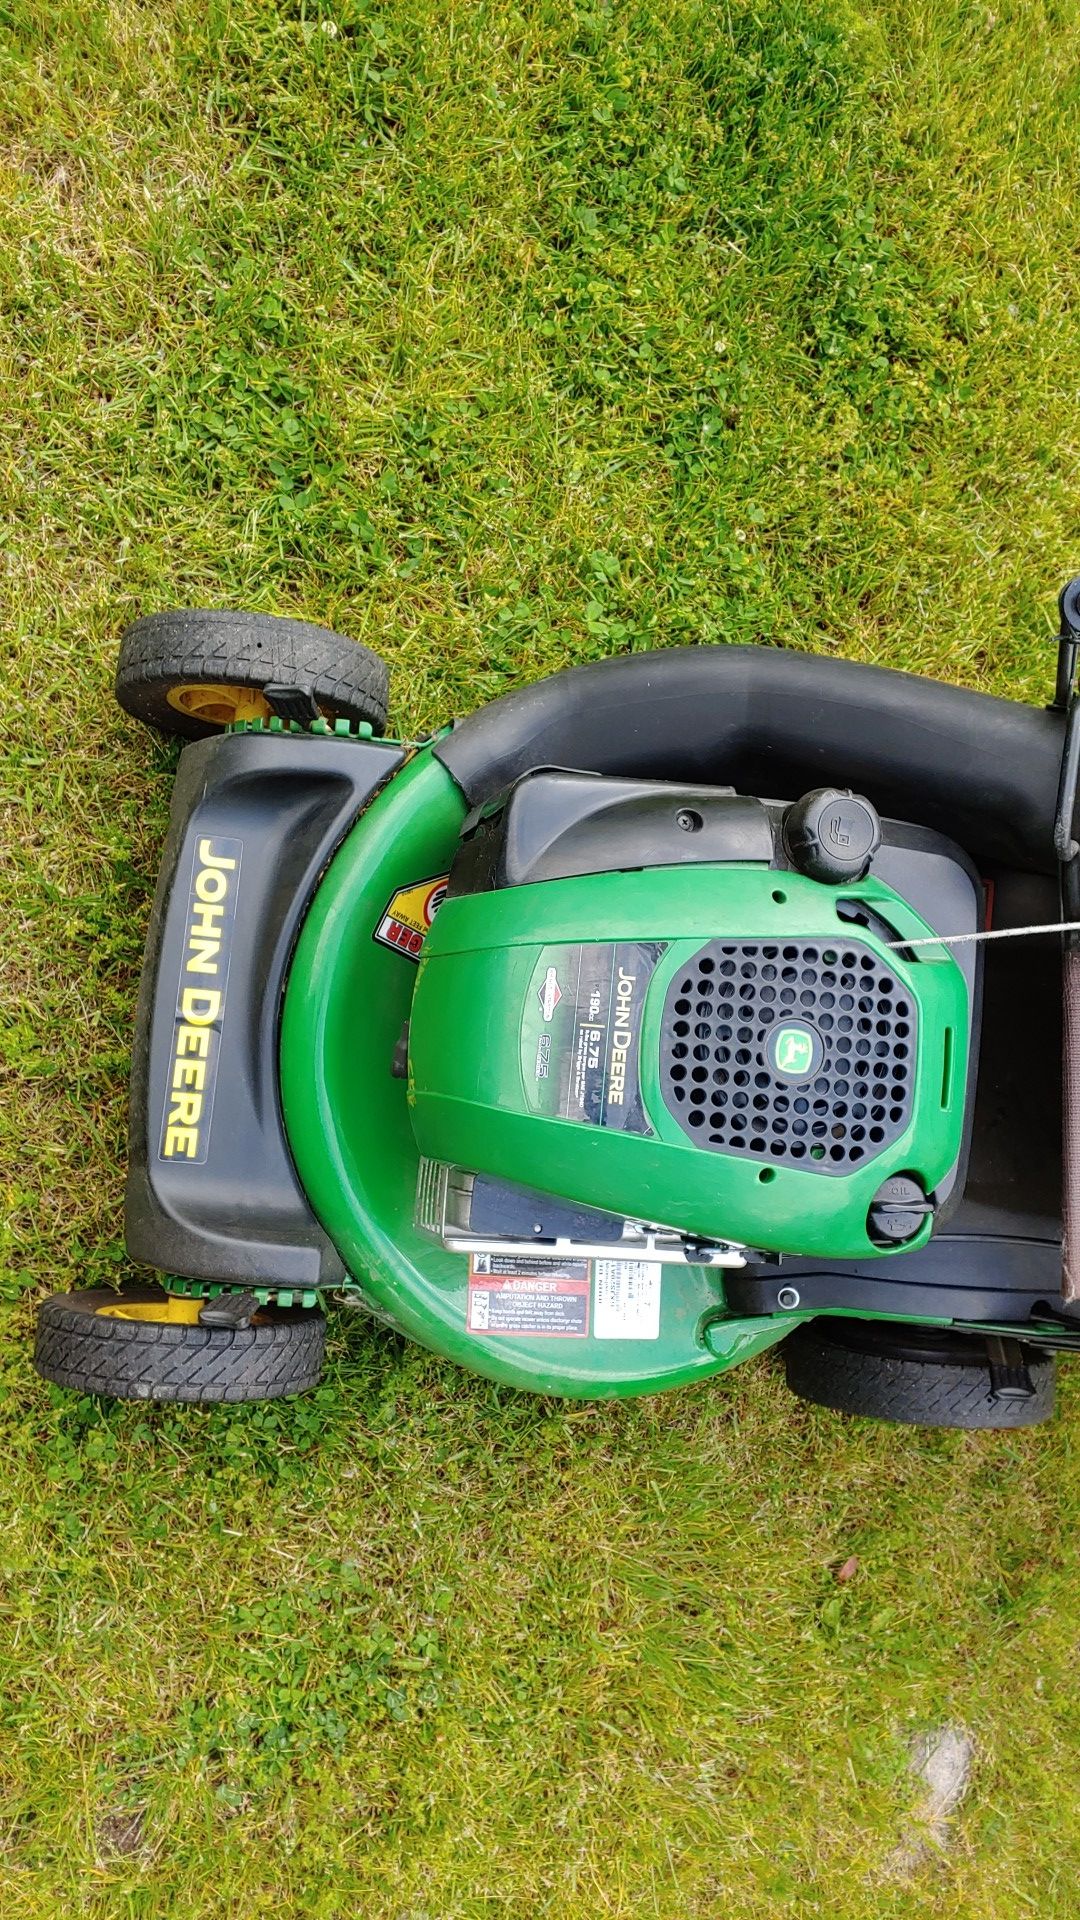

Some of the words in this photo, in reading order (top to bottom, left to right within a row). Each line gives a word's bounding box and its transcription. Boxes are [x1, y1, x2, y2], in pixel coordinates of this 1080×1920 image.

[187, 839, 236, 974] JOHN
[392, 909, 409, 922] AWAY
[386, 920, 423, 953] GER
[409, 919, 423, 930] FEET
[614, 967, 636, 1027] JOHN
[540, 1034, 551, 1078] 675
[587, 1030, 600, 1069] 6.75
[164, 988, 221, 1158] DEERE
[608, 1031, 631, 1105] DEERE
[890, 1187, 911, 1196] OIL
[496, 1293, 535, 1301] AMPUTATION
[513, 1280, 557, 1292] DANGER
[512, 1301, 537, 1309] OBJECT
